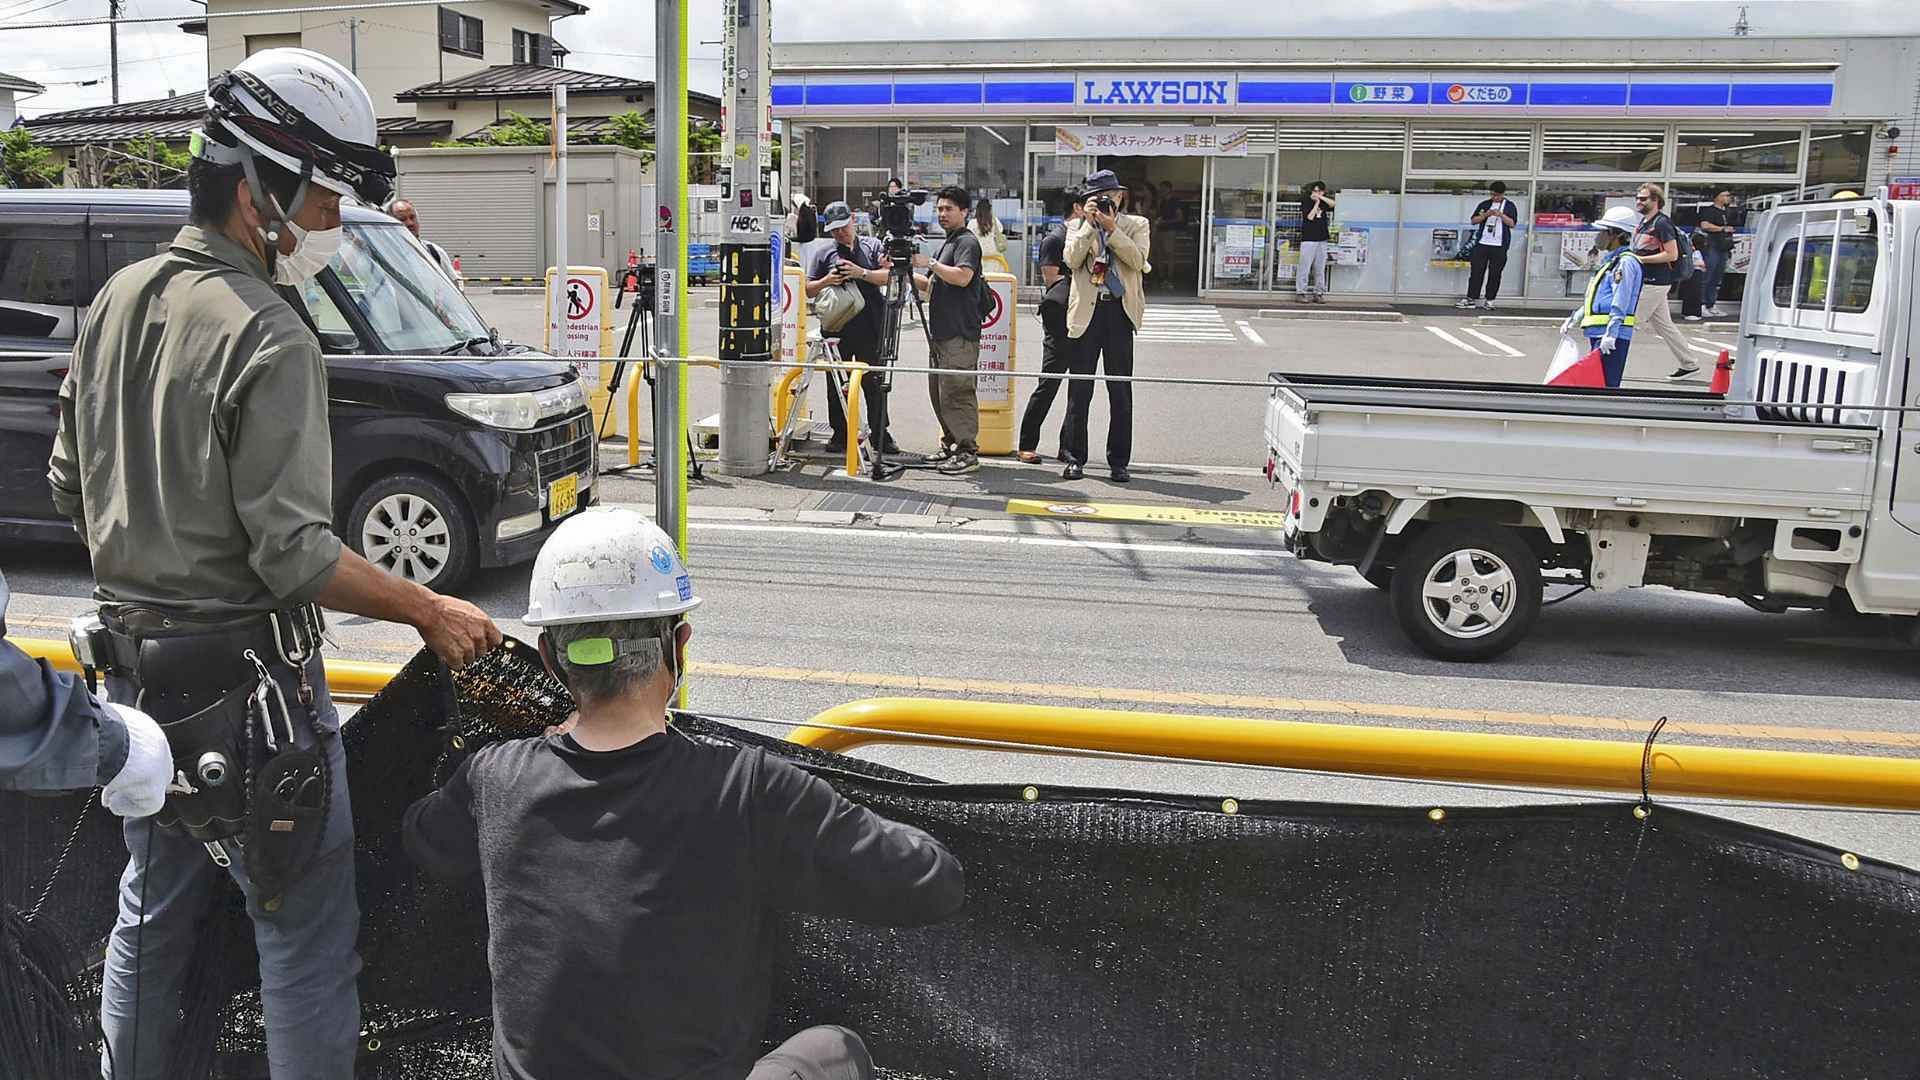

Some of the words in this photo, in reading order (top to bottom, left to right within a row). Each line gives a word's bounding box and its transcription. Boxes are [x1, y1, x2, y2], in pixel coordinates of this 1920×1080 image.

[1084, 80, 1228, 104] LAWSON
[1373, 86, 1406, 100] 野菜
[1467, 87, 1509, 101] くだもの
[567, 323, 599, 331] destrian
[567, 332, 589, 341] ossing
[979, 333, 1007, 341] estrian
[978, 342, 997, 352] sing
